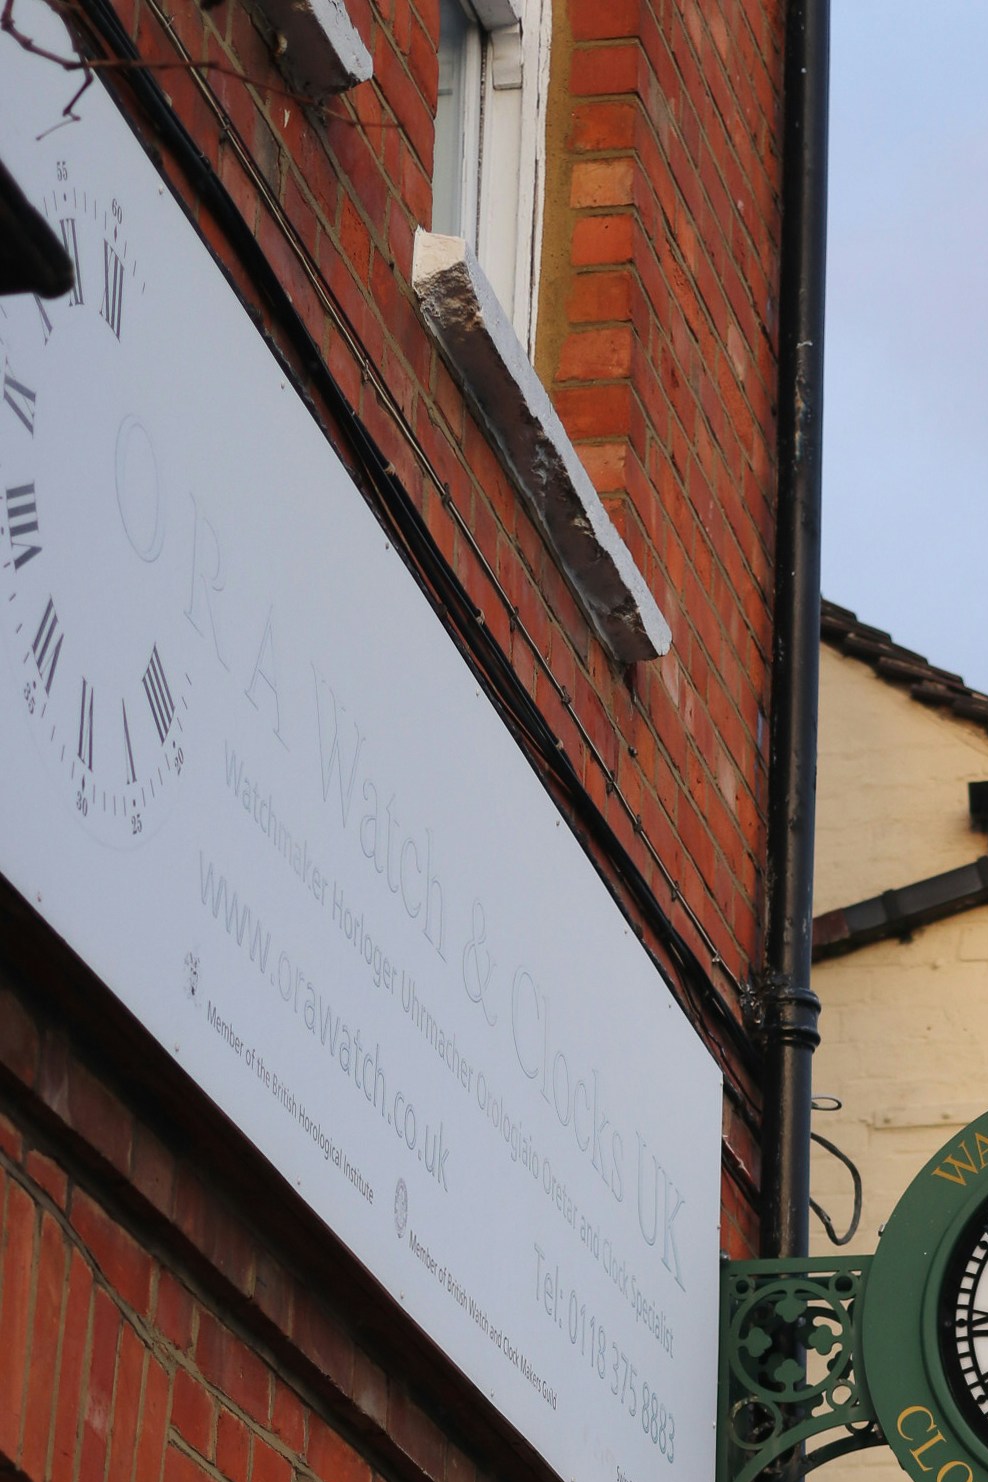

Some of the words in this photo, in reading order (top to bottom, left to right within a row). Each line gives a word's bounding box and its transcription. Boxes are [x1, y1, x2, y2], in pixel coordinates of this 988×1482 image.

[111, 198, 122, 224] 60
[99, 237, 125, 343] XII
[142, 641, 176, 747] IIII
[173, 747, 185, 776] 20
[75, 789, 89, 817] 30
[115, 414, 290, 752] ORA
[310, 660, 447, 963] Watch
[463, 898, 497, 1026] &
[511, 967, 624, 1202] Clocks
[635, 1130, 686, 1293] UK
[131, 812, 143, 835] 25
[200, 848, 448, 1192] www.orawatch.co.uk
[225, 738, 328, 906] Watchmaker
[333, 881, 398, 995] Horloger
[402, 970, 474, 1093] Uhrmacher
[477, 1072, 539, 1180] Orologiaio
[580, 1215, 600, 1261] and
[603, 1239, 628, 1299] Clock
[631, 1275, 674, 1359] Specialist
[207, 1000, 245, 1057] Member
[246, 1049, 256, 1068] of
[257, 1058, 271, 1088] the
[272, 1073, 298, 1120] British
[298, 1105, 343, 1169] Horological
[343, 1150, 374, 1205] Institute
[409, 1230, 438, 1277] Member
[438, 1267, 447, 1286] of
[447, 1274, 468, 1308] British
[469, 1297, 489, 1336] Watch
[489, 1325, 503, 1348] and
[503, 1336, 520, 1370] Clock
[520, 1355, 542, 1393] Makers
[542, 1381, 557, 1411] Guild
[534, 1242, 563, 1329] Tel:
[569, 1290, 606, 1379] 0118
[612, 1342, 638, 1416] 375
[642, 1381, 675, 1463] 8883
